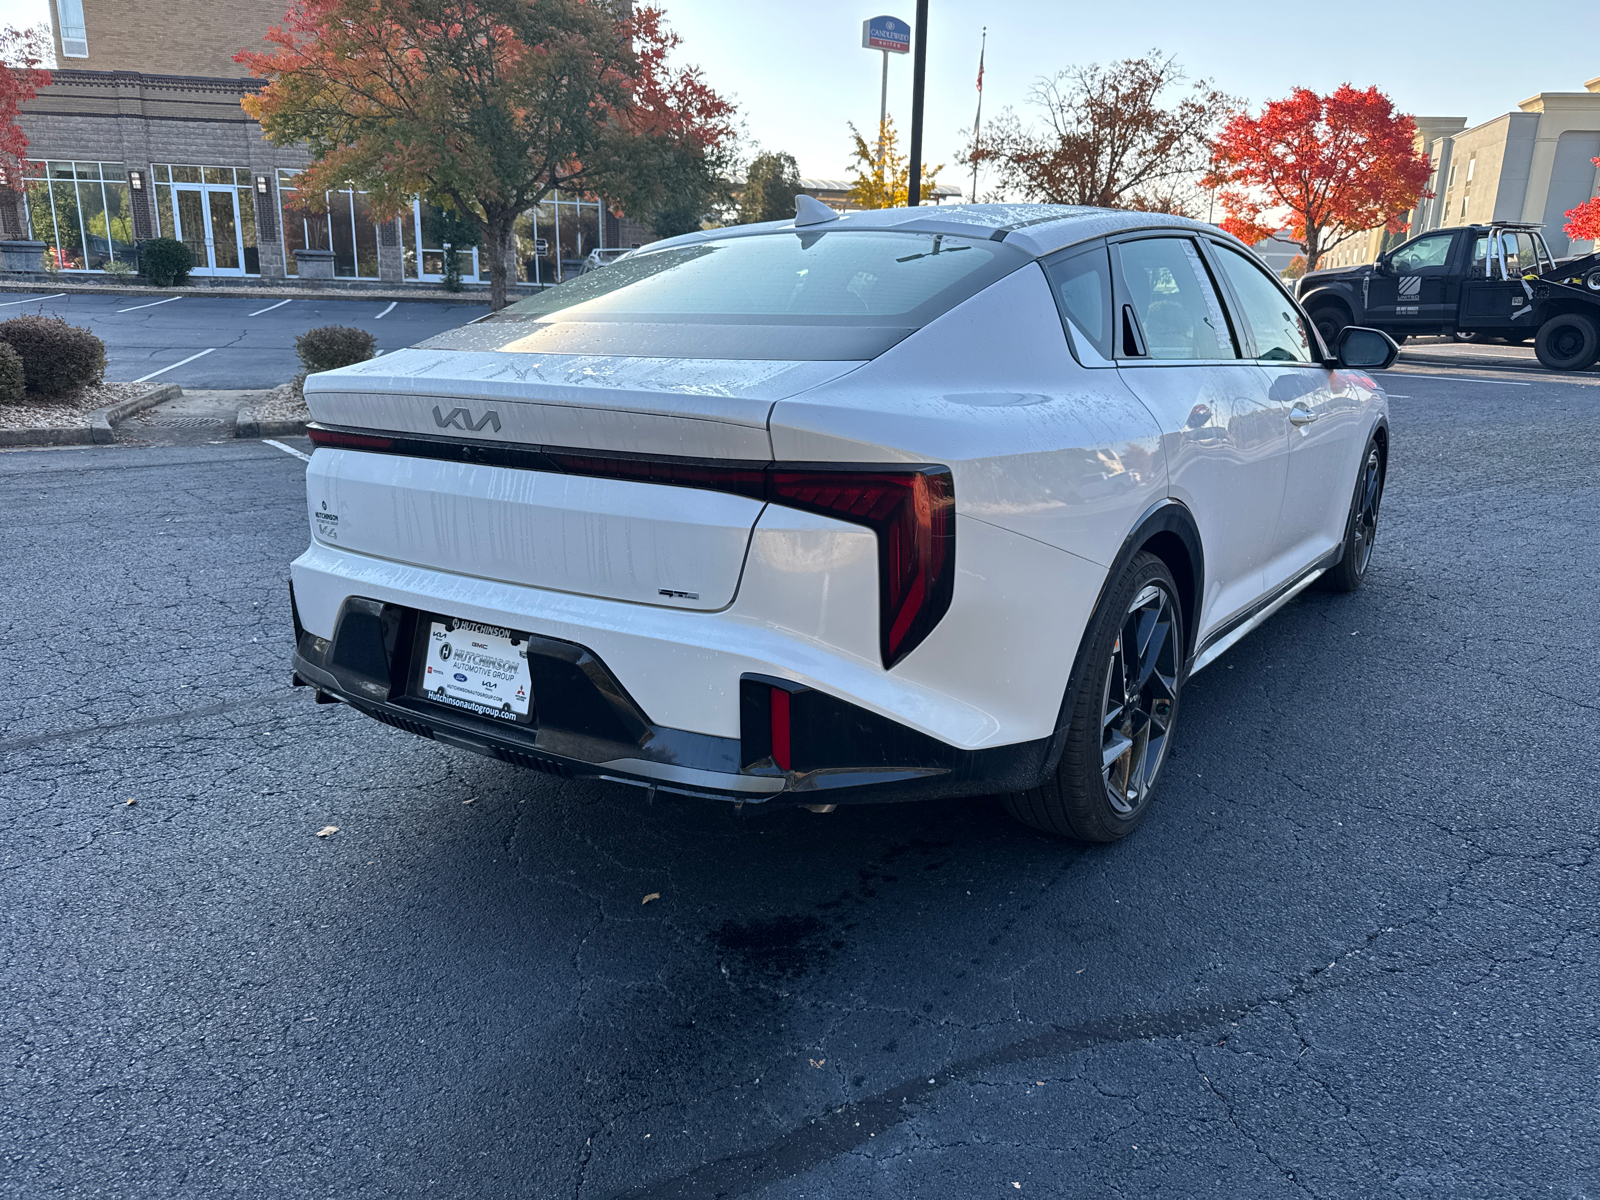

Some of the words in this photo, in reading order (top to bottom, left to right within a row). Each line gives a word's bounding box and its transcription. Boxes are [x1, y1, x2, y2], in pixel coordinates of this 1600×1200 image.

[432, 405, 502, 433] KIA
[461, 621, 511, 639] HUTCHINSON
[471, 641, 489, 650] GMC
[452, 661, 492, 677] AUTOMOTIVE
[492, 671, 515, 682] GROUP
[453, 649, 519, 674] HUTCHINSON
[447, 684, 503, 702] HUTCHINSONAUTOGROUP.COM
[428, 691, 516, 720] Hutchinsonautogroup.com
